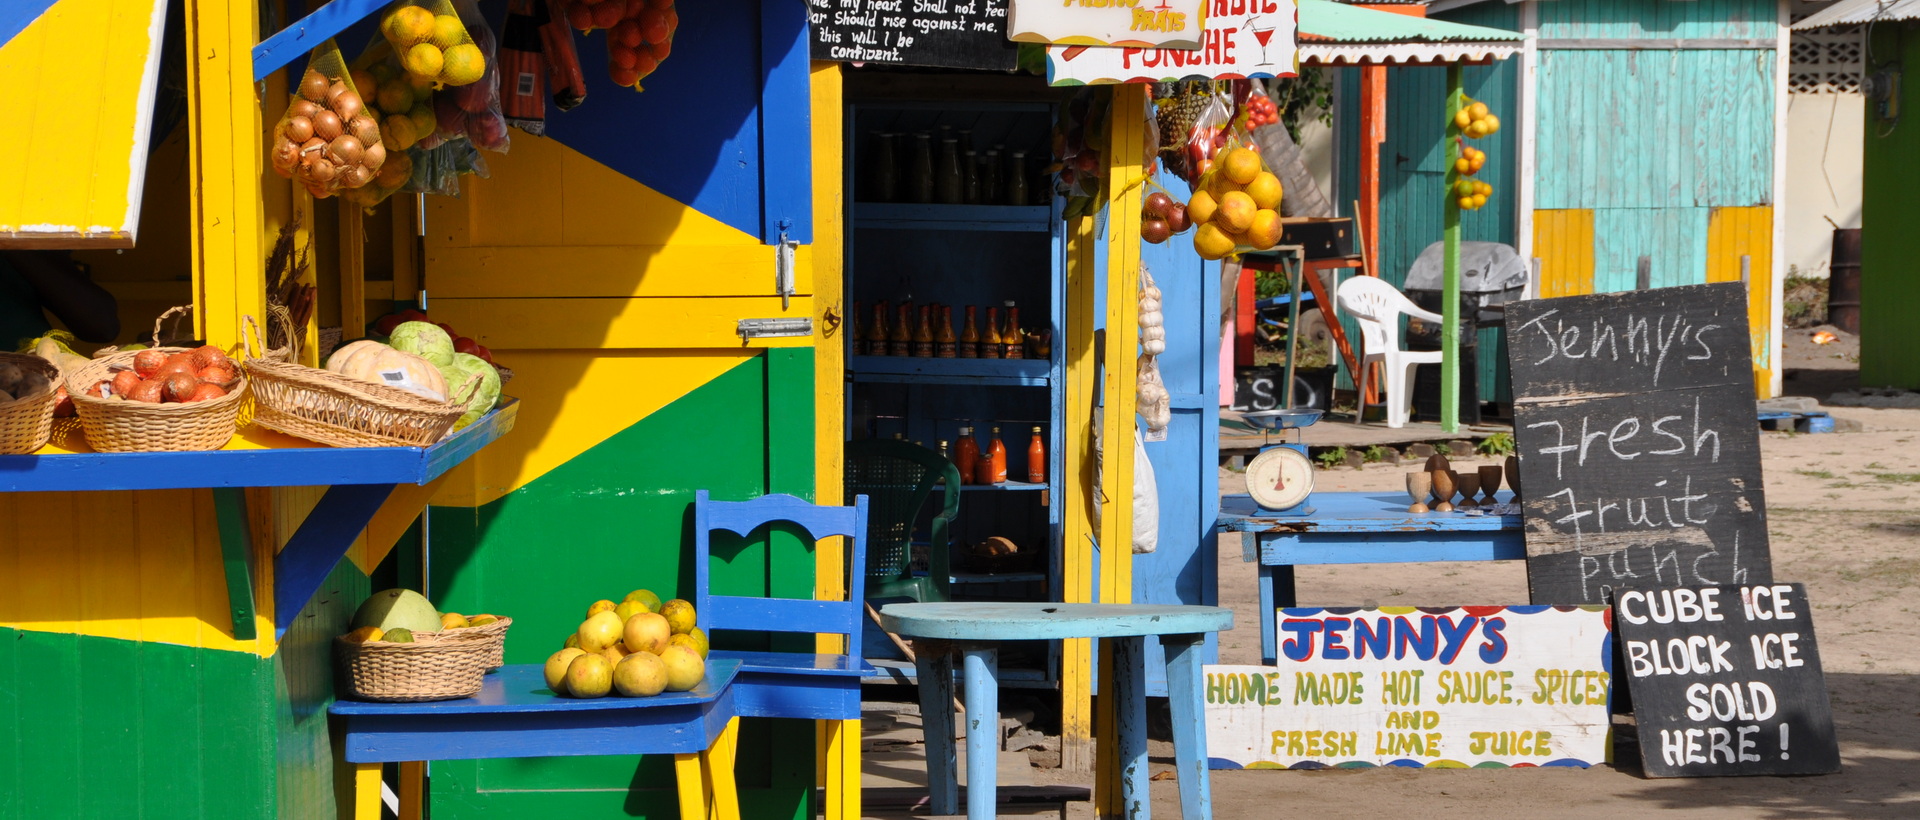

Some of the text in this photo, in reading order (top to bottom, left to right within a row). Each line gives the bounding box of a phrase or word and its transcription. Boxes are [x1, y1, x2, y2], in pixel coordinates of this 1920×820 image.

[809, 12, 828, 24] ar
[882, 16, 907, 29] rise
[912, 15, 967, 34] against
[973, 21, 998, 33] me.
[840, 0, 861, 13] my
[867, 0, 903, 12] heart
[954, 0, 977, 14] not
[820, 26, 842, 43] this
[896, 31, 914, 48] be
[1579, 530, 1749, 601] punch
[1620, 588, 1725, 626] CUBE
[1741, 585, 1796, 622] ICE
[1281, 615, 1509, 665] JENNY'S
[1626, 632, 1804, 678] BLOCK ICE
[1207, 672, 1281, 706] HOME
[1294, 671, 1364, 706] MADE
[1381, 669, 1425, 706] HOT
[1531, 668, 1610, 706] SPICES
[1686, 681, 1777, 723] SOLD
[1385, 710, 1440, 730] AND
[1270, 730, 1552, 757] FRESH LIME JUICE
[1660, 724, 1762, 766] HERE
